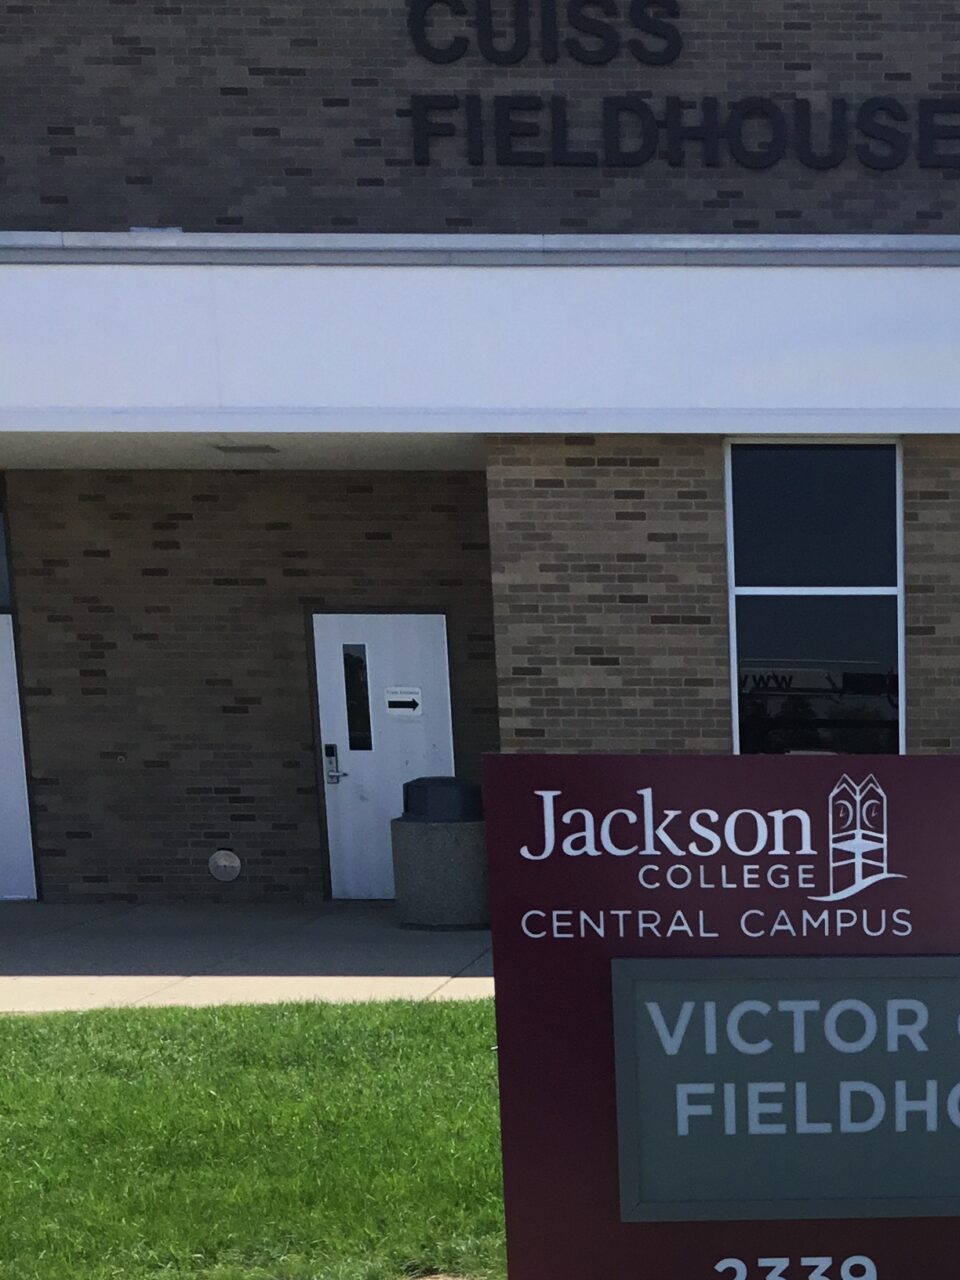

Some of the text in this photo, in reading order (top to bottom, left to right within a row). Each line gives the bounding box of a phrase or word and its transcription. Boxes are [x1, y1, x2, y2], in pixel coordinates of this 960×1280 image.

[406, 0, 684, 66] CUISS
[520, 788, 817, 859] Jackson
[639, 864, 815, 888] COLLEGE
[522, 909, 912, 938] CENTRAL CAMPUS
[646, 999, 928, 1055] VICTOR
